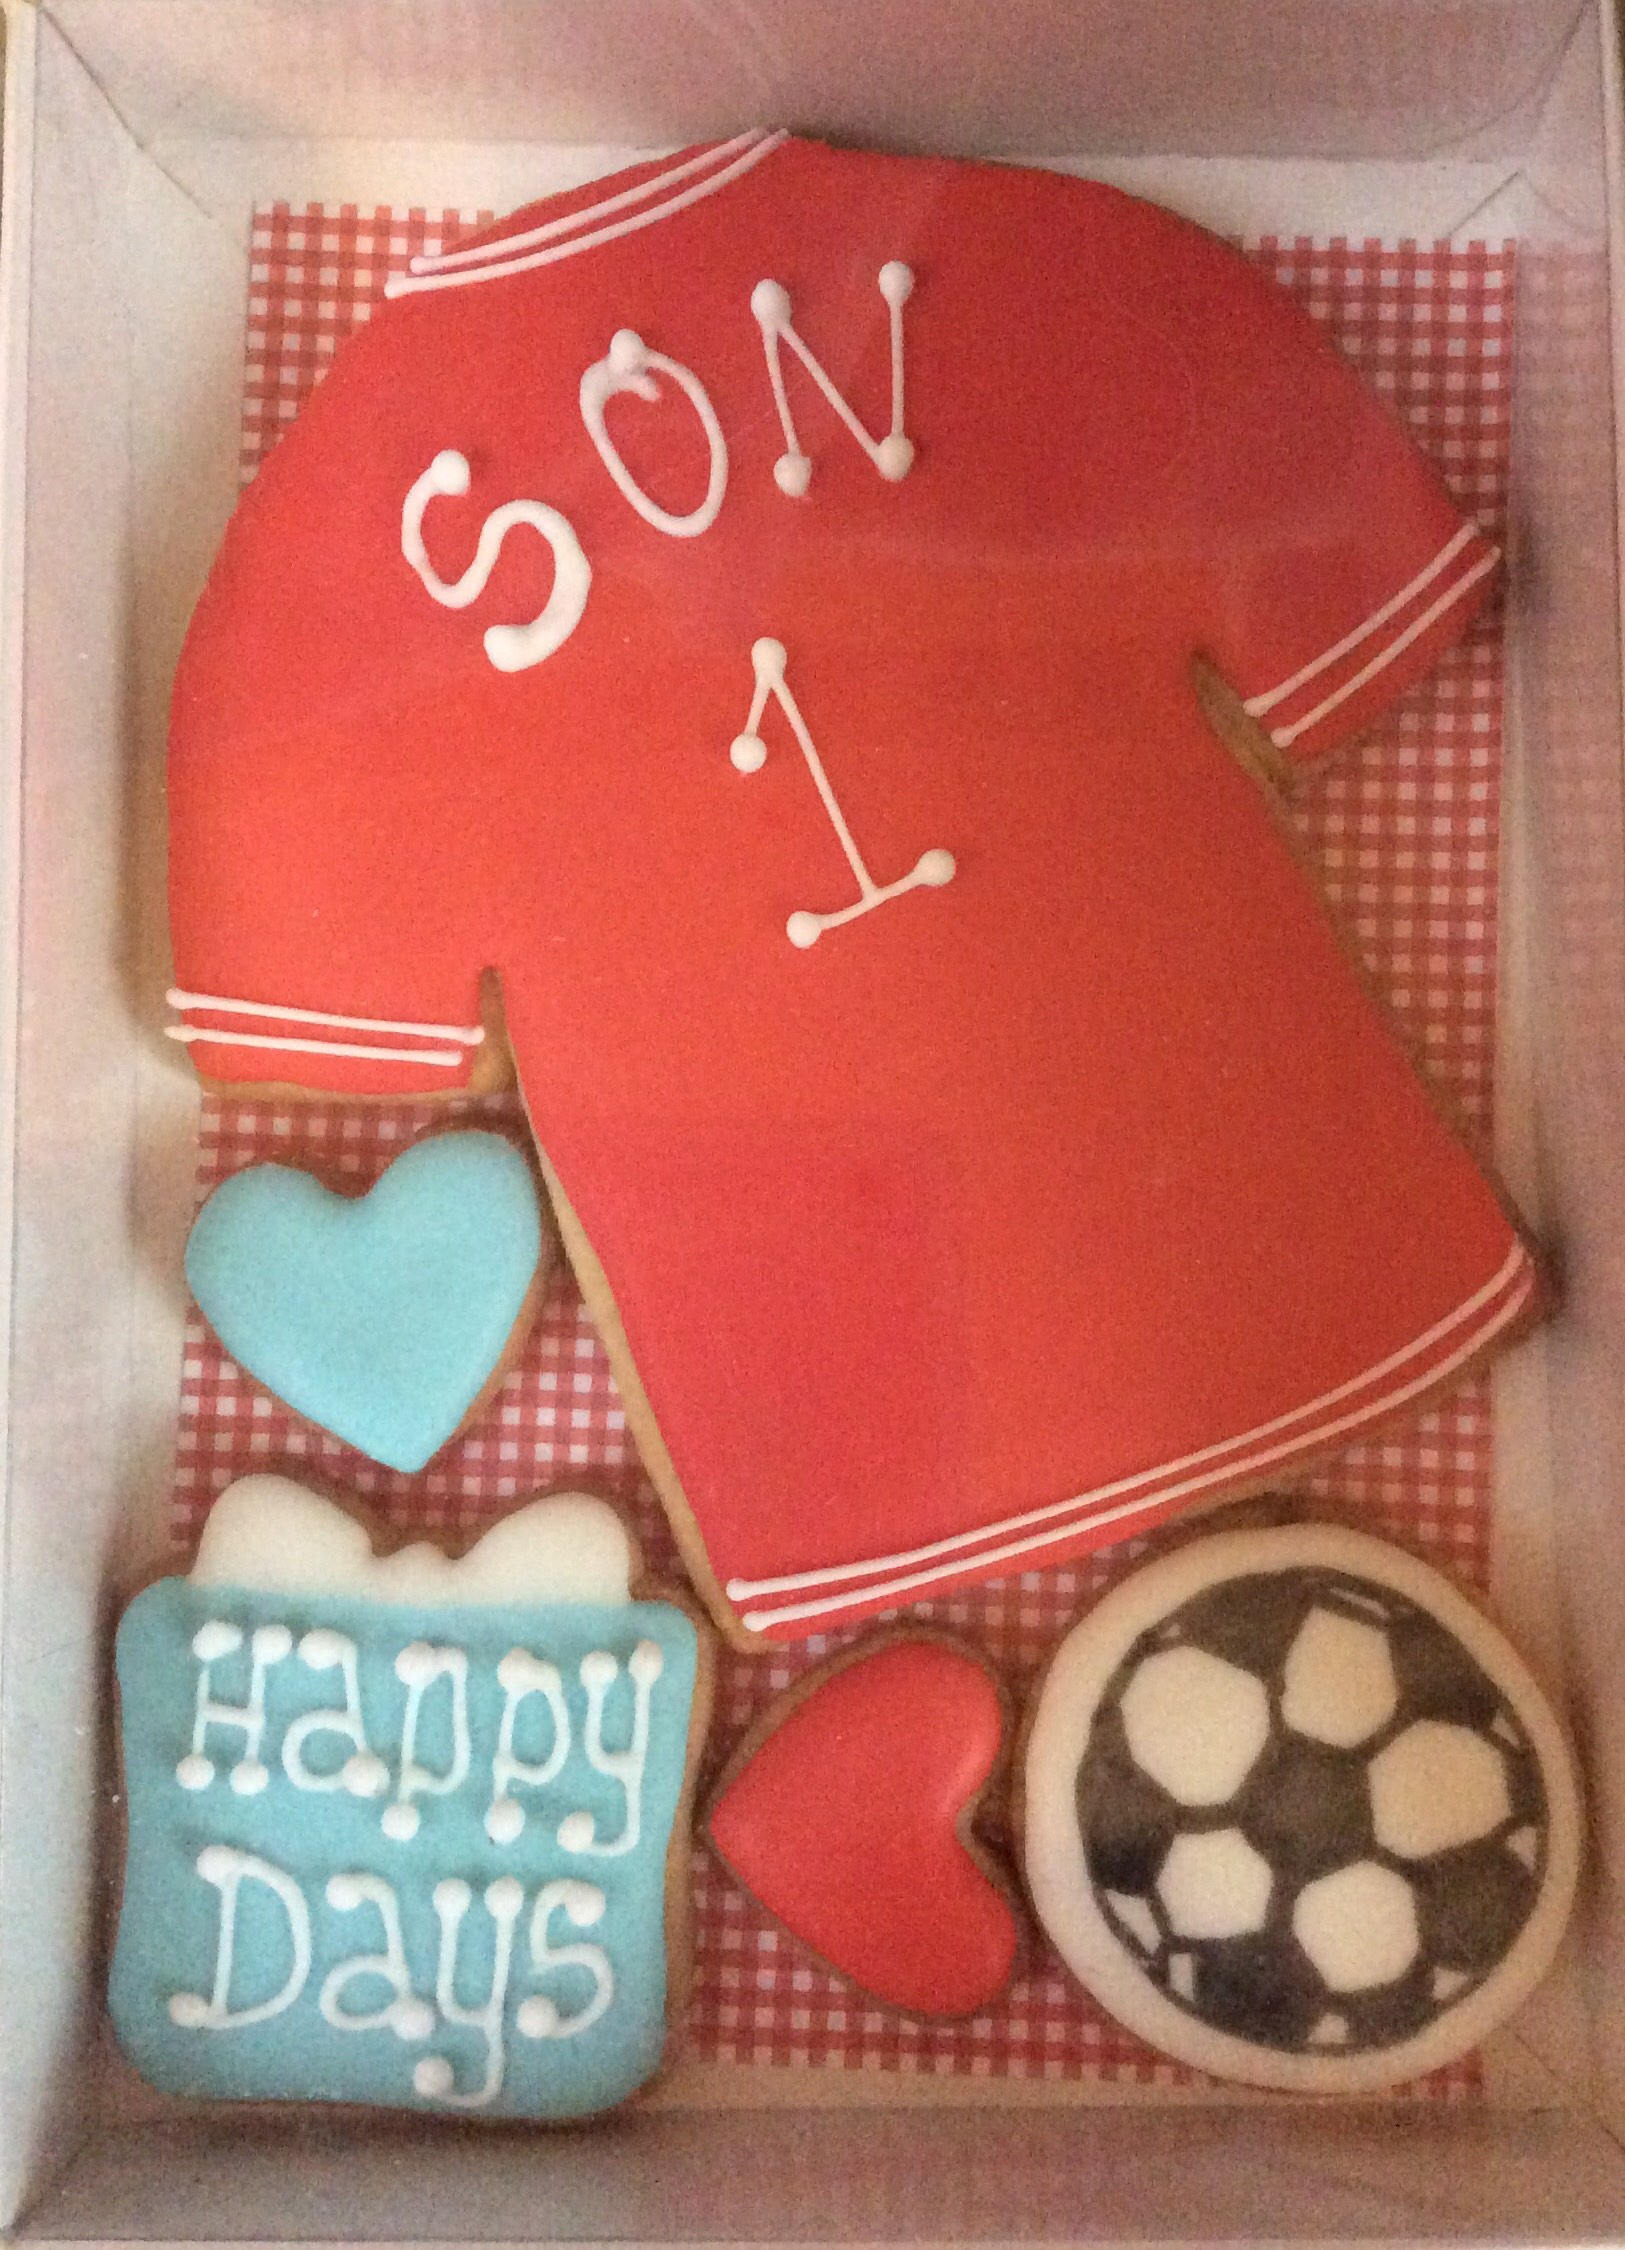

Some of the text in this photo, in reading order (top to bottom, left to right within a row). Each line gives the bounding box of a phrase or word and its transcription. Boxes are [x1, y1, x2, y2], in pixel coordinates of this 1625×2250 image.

[401, 261, 914, 672] SON
[730, 637, 956, 949] 1
[176, 1621, 663, 1857] Happy
[169, 1845, 613, 2108] Days
